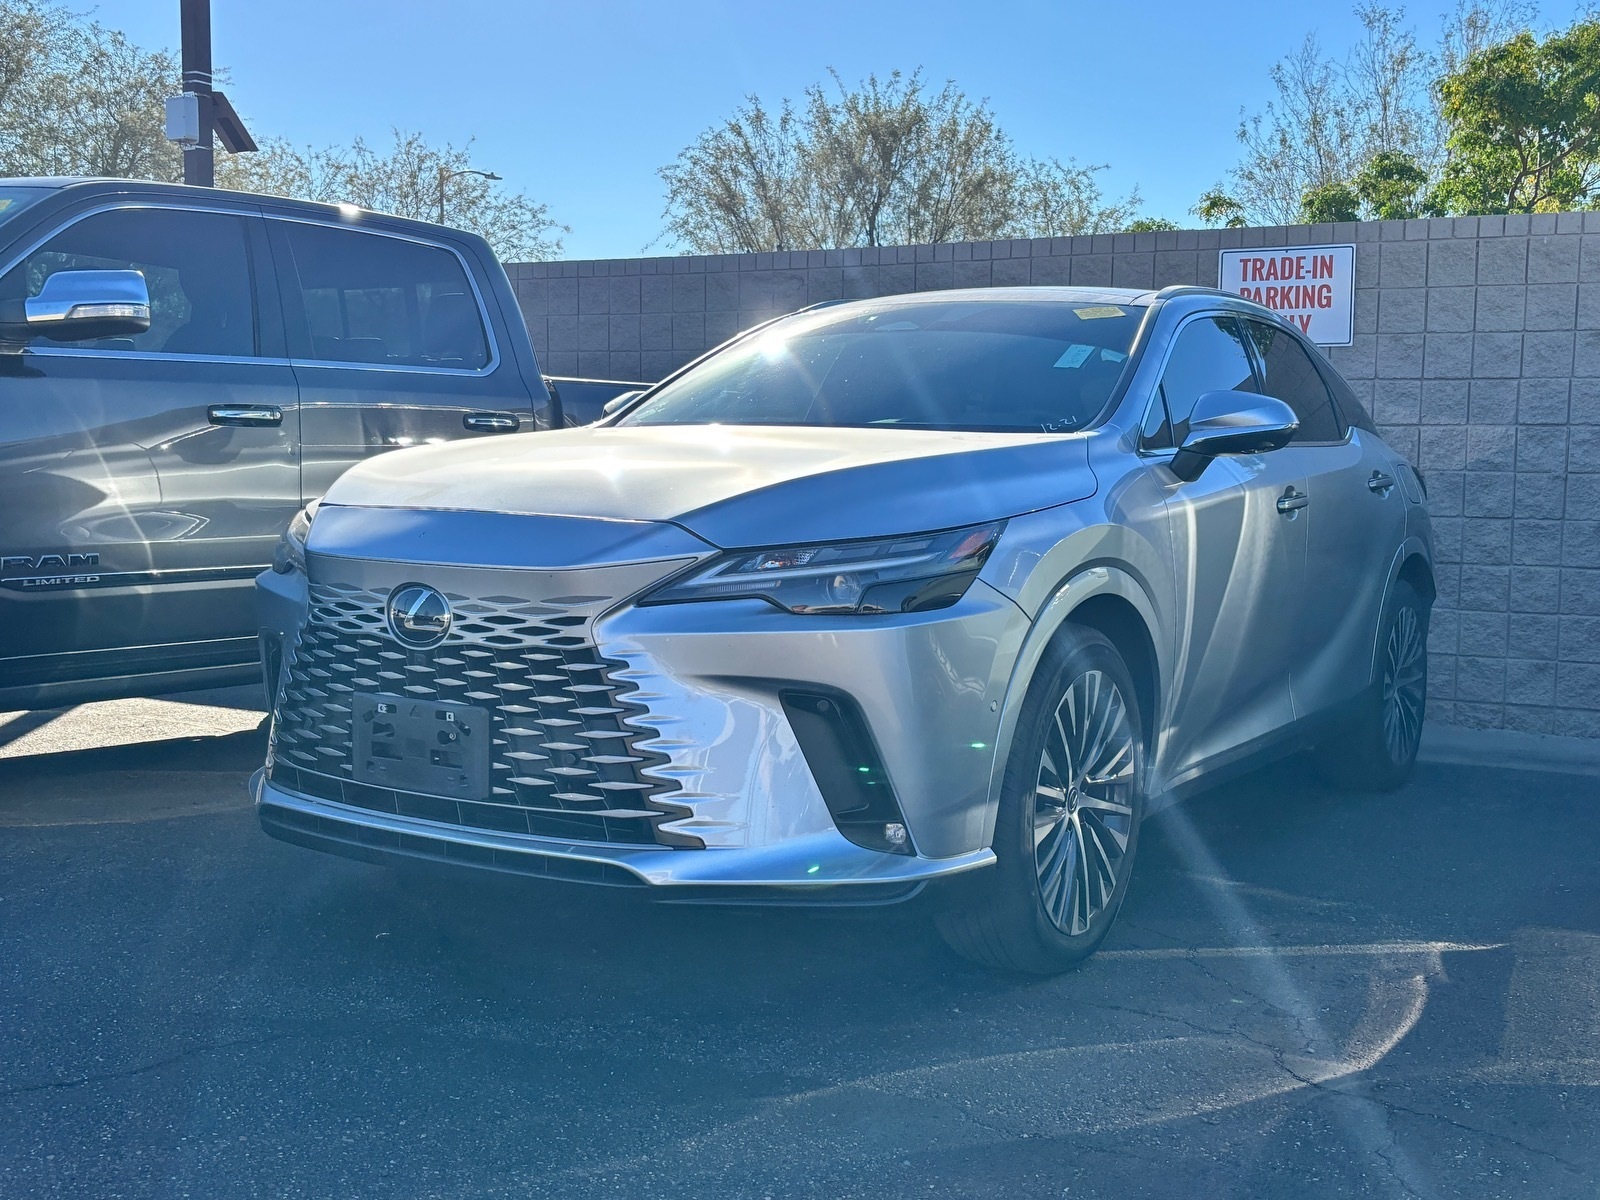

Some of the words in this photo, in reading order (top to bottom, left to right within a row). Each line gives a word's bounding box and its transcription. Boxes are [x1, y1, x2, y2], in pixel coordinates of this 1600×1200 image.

[1239, 255, 1334, 282] TRADE-IN
[0, 552, 100, 571] RAM
[23, 575, 101, 587] LIMITED
